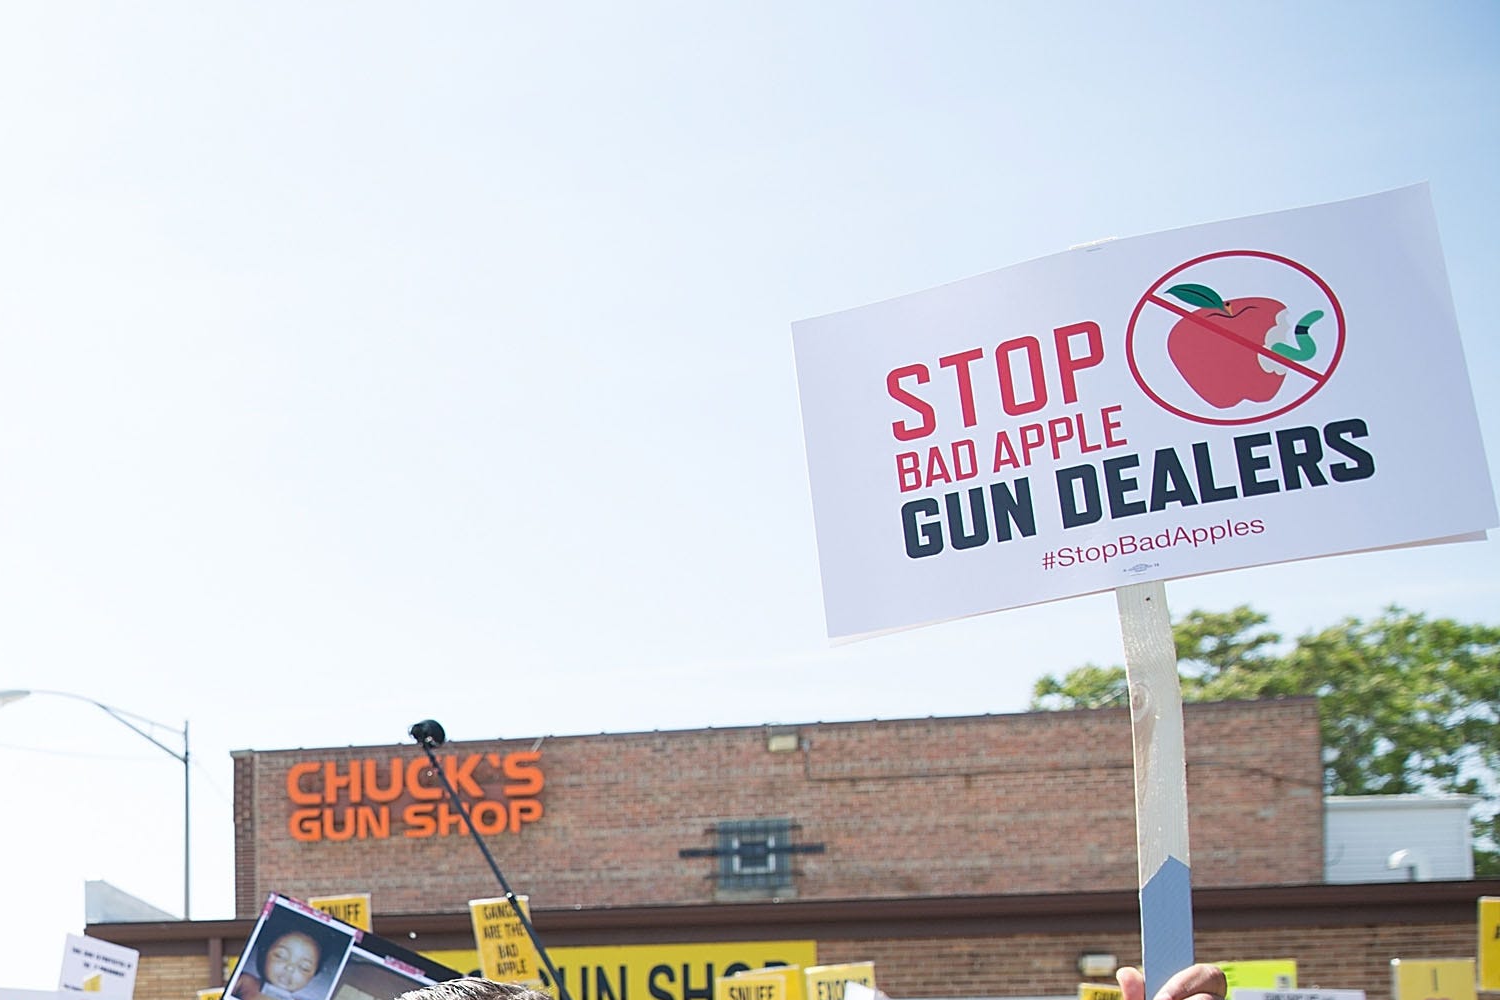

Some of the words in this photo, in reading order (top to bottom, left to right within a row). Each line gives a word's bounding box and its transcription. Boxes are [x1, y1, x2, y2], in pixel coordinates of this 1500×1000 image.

[886, 320, 1106, 443] STOP
[895, 438, 979, 495] BAD
[992, 405, 1129, 475] APPLE
[900, 476, 1038, 560] GUN
[1055, 418, 1377, 532] DEALERS
[1041, 518, 1266, 571] #StopBadApples
[286, 751, 545, 806] CHUCK'S
[289, 806, 391, 842] GUN
[403, 800, 545, 839] SHOP
[321, 903, 361, 921] NUFF
[1431, 968, 1438, 992] I
